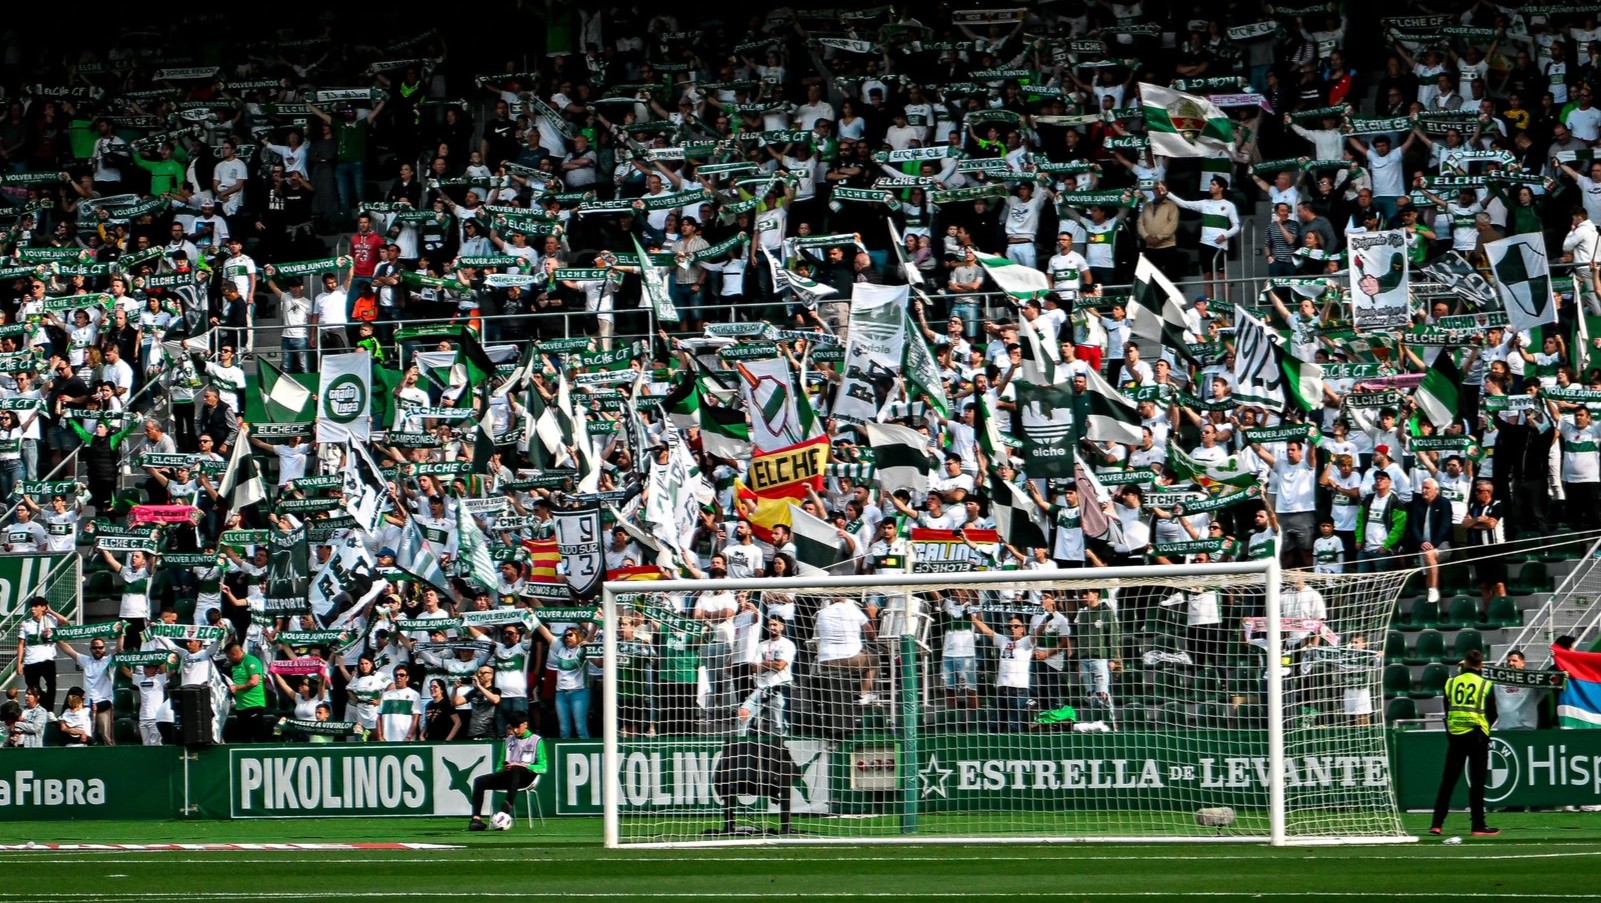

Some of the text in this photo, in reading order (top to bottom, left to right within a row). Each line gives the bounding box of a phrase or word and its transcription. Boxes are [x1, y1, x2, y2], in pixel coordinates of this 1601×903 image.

[1431, 17, 1444, 26] CF
[1469, 27, 1493, 35] JUNTOS
[955, 41, 971, 50] CF
[227, 80, 277, 89] VOLVER JUNTOS
[1022, 85, 1046, 93] VOLVER
[1355, 121, 1388, 131] ELCHE
[792, 132, 807, 141] CF
[717, 140, 731, 148] CF
[6, 174, 33, 182] VOLVER
[986, 170, 1010, 178] VOLVER
[878, 177, 932, 185] ELCHE CF
[1434, 176, 1485, 185] ELCHE
[649, 192, 701, 207] VOLVER JUNTOS
[1065, 194, 1118, 203] VOLVER JUNTOS
[112, 200, 160, 217] VOLVER JUNTOS
[484, 205, 543, 216] VOLVER JUNTOS
[508, 219, 551, 233] ELCHE CF
[24, 249, 79, 258] VOLVER JUNTOS
[697, 247, 718, 258] VOLVER
[461, 257, 489, 265] VOLVER
[62, 264, 104, 275] ELCHE CF
[278, 260, 334, 274] VOLVER JUNTOS
[592, 270, 604, 278] CF
[151, 275, 175, 286] ELCHE
[45, 299, 68, 308] ELCHE
[1488, 313, 1507, 327] ELC
[1405, 334, 1464, 343] ELCHE CF
[539, 341, 588, 350] VOLVER JUNTOS
[722, 346, 776, 356] VOLVER JUNTOS
[811, 351, 838, 359] VOLVER
[584, 348, 630, 366] ELCHE CF
[17, 360, 34, 370] CF
[1355, 363, 1371, 376] CF
[1546, 387, 1575, 397] VOLVER
[1348, 395, 1385, 405] ELCHE
[337, 402, 359, 413] 1923
[104, 410, 118, 419] CF
[1246, 427, 1306, 439] VOLVER JUNTOS
[390, 434, 434, 444] CAMPEONES
[1412, 439, 1441, 447] VOLVER
[1032, 447, 1066, 457] elche
[152, 456, 183, 465] ELCHE
[419, 462, 459, 474] ELCHE
[754, 448, 821, 488] ELCHE
[296, 476, 326, 486] VOLVER
[1124, 472, 1154, 481] JUNTOS
[26, 483, 69, 493] ELCHE CF
[1185, 491, 1244, 512] VOLVER JUNTOS
[98, 526, 150, 535] VOLVER JUNTOS
[224, 533, 250, 543] ELCHE
[99, 539, 125, 548] ELCHE
[579, 543, 599, 554] SUR
[1156, 540, 1219, 552] VOLVER JUNTOS
[191, 555, 217, 563] JUNTOS
[494, 549, 510, 560] CF
[528, 585, 550, 595] SOMOS
[562, 610, 592, 618] JUNTOS
[398, 618, 458, 628] VOLVER JUNTOS
[56, 624, 111, 636] VOLVER JUNTOS
[282, 631, 337, 640] VOLVER JUNTOS
[586, 646, 603, 655] ELC
[115, 652, 167, 662] VOLVER JUNTOS
[1482, 670, 1544, 684] ELCHE CF
[1454, 683, 1475, 705] 62
[956, 758, 1163, 790] ESTRELLA
[1170, 766, 1194, 780] DE
[240, 754, 426, 809] PIKOLINOS
